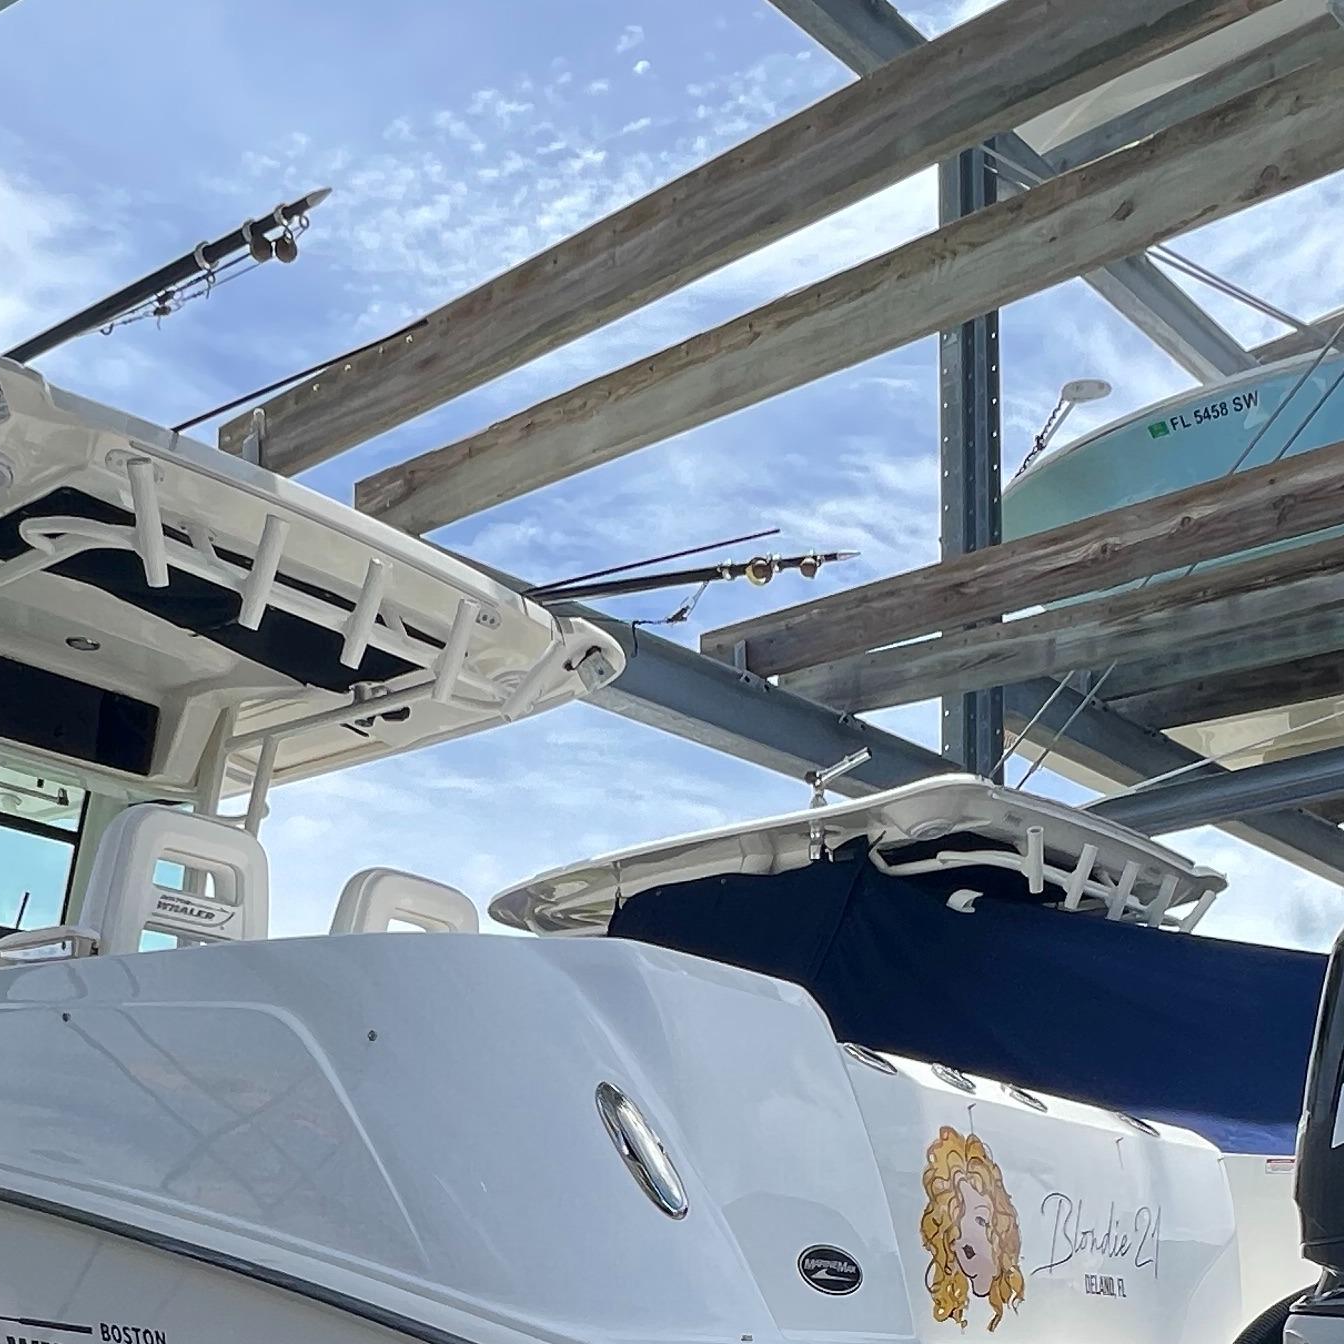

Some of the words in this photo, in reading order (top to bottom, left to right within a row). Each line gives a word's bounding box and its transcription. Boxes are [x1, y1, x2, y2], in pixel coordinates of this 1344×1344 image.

[1169, 415, 1192, 431] FL
[1193, 402, 1229, 425] 5458
[1231, 390, 1259, 413] SW
[1030, 1192, 1132, 1276] Blondie
[1117, 1278, 1128, 1298] FL
